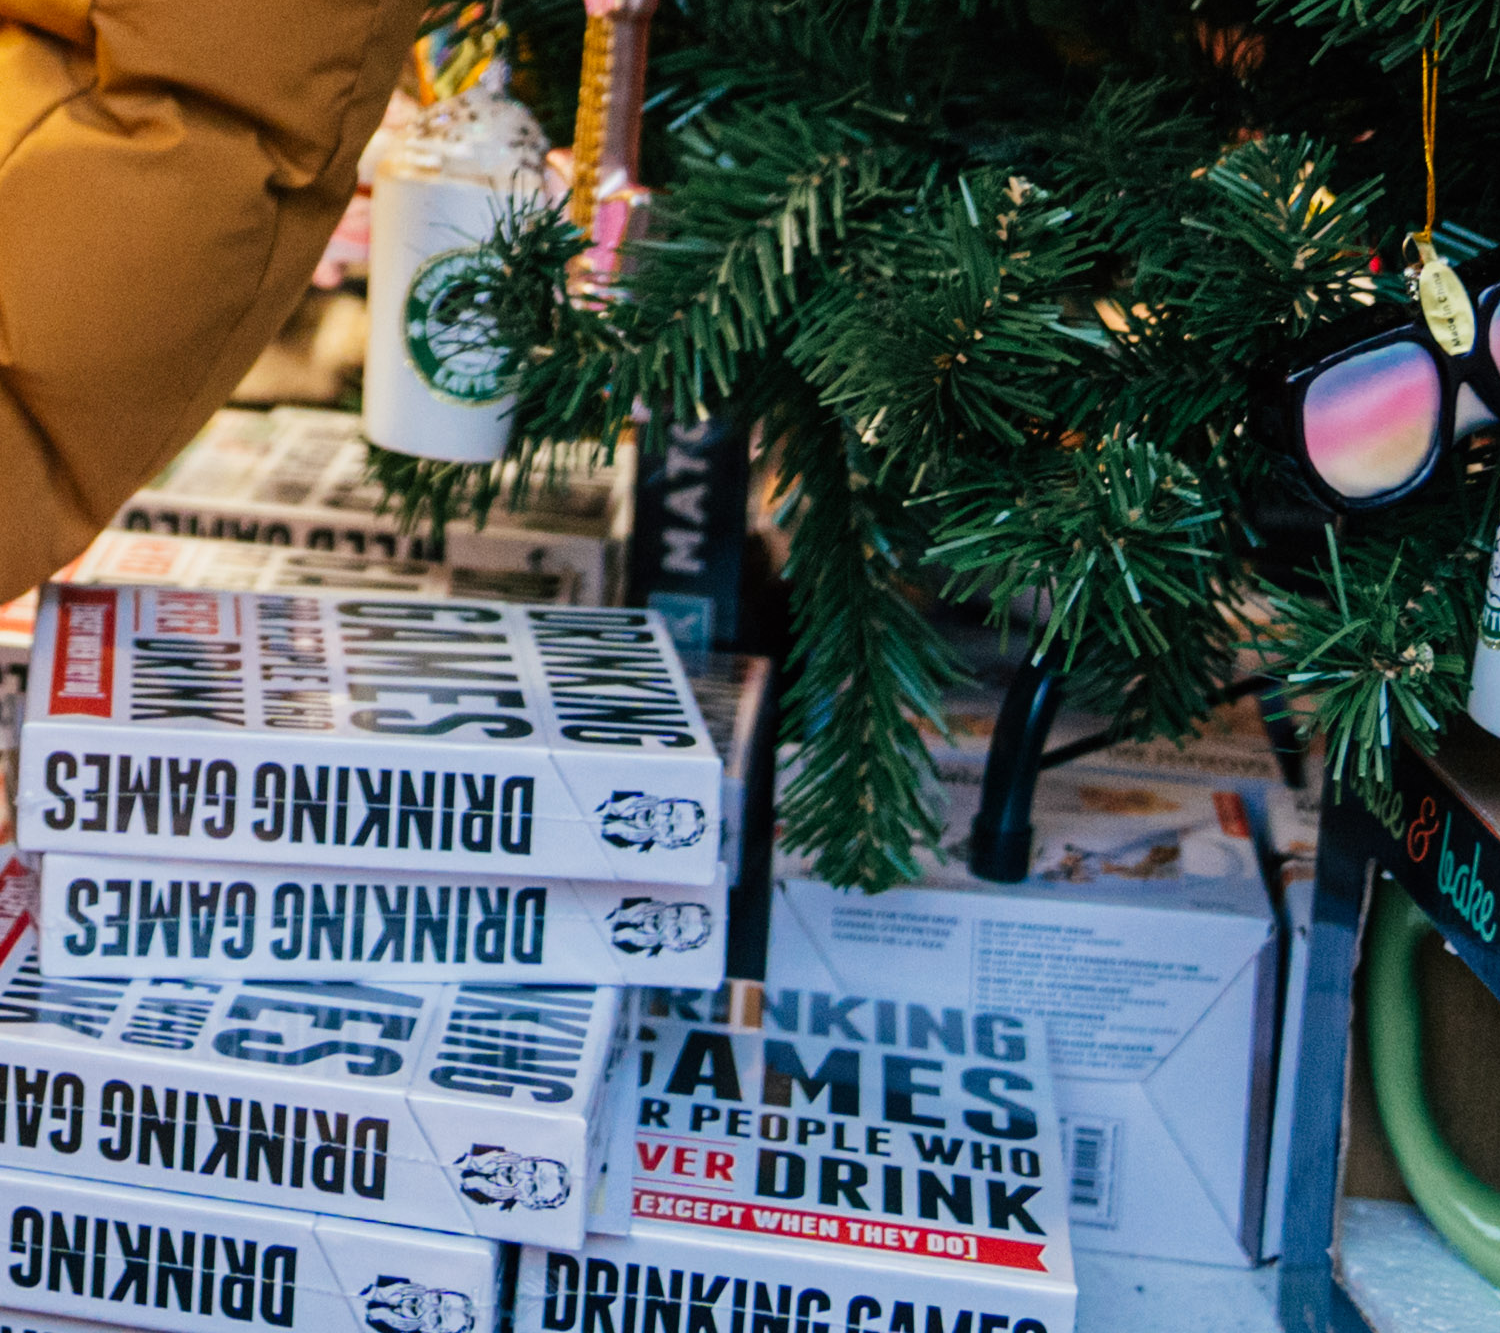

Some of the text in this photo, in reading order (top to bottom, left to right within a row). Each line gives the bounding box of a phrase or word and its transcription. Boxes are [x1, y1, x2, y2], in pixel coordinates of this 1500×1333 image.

[1447, 316, 1461, 348] Made
[129, 637, 246, 727] DRINK
[261, 688, 336, 731] WHO
[336, 600, 534, 740] GAMES
[526, 609, 698, 749] DRINKING
[43, 750, 536, 857] DRINKING GAMES
[1406, 796, 1439, 863] &
[1437, 811, 1498, 944] bake
[63, 877, 257, 961] GAMES
[271, 882, 548, 966] DRINKING
[119, 997, 215, 1051] WHO
[429, 983, 599, 1104] NKING
[641, 985, 1027, 1063] RINKING
[97, 1078, 390, 1202] DRINKING
[689, 1103, 894, 1158] PEOPLE
[912, 1132, 1042, 1179] WHO
[630, 1189, 979, 1261] [EXCEPT WHEN THEY DO]
[635, 1140, 1048, 1237] VER DRINK
[8, 1205, 299, 1330] DRINKING
[541, 1251, 832, 1333] DRINKING
